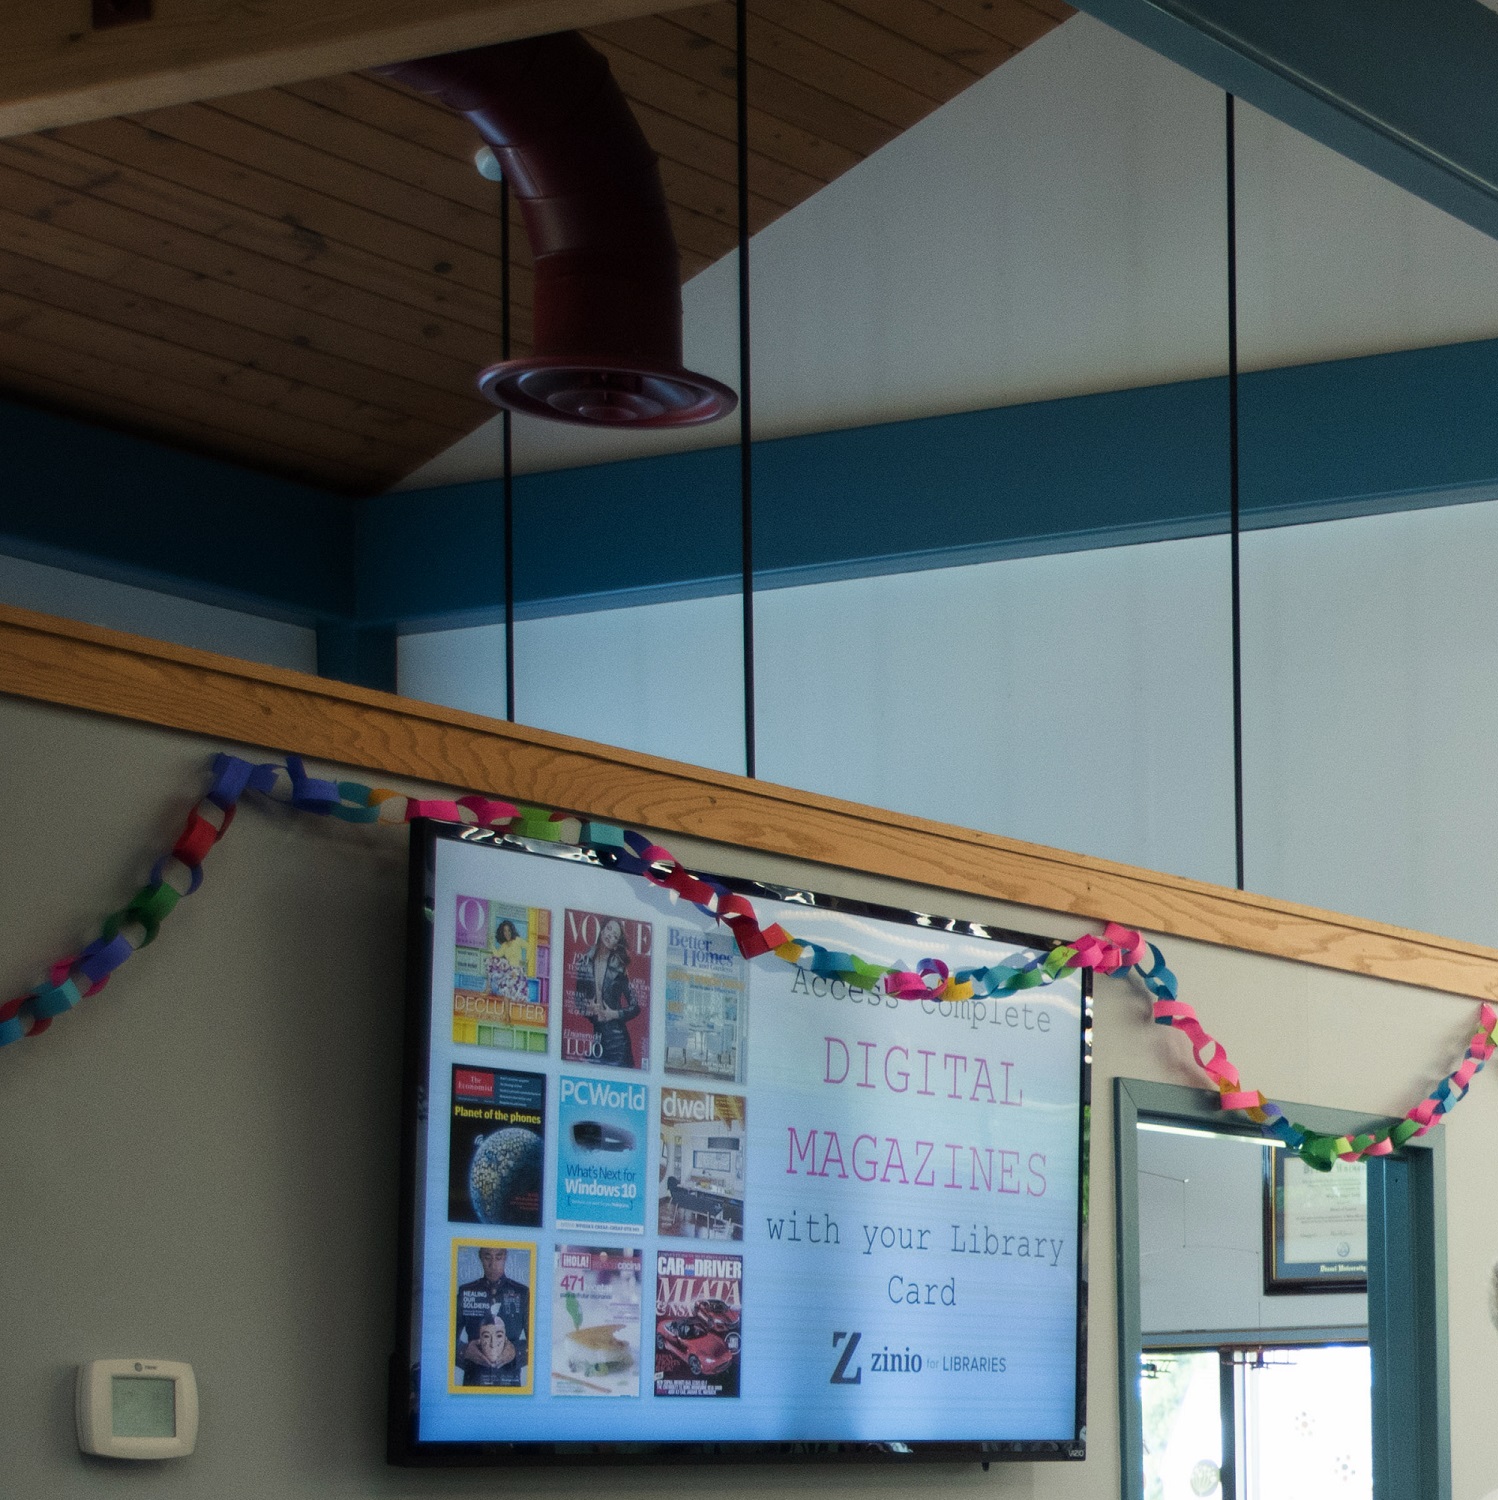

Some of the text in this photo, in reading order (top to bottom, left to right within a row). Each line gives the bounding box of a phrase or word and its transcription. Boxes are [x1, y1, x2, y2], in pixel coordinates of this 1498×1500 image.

[568, 911, 650, 956] VOE
[669, 928, 712, 951] Better
[682, 950, 733, 966] Homes
[567, 1039, 603, 1057] LUJO
[824, 1036, 1023, 1107] DIGITAL
[459, 1082, 493, 1092] Economist
[561, 1079, 645, 1111] PCWorld
[455, 1105, 541, 1124] Planet of the phones
[663, 1091, 714, 1120] dwell
[566, 1164, 636, 1180] What's Next for
[786, 1127, 1047, 1197] MAGAZINES
[565, 1178, 636, 1198] Windows 10
[766, 1210, 1064, 1267] with your Library
[658, 1257, 684, 1276] CAR
[695, 1260, 742, 1279] DRIVER
[560, 1275, 585, 1290] 471
[657, 1278, 741, 1308] MIATA
[888, 1275, 957, 1306] Card
[870, 1346, 923, 1373] zinio
[926, 1358, 940, 1370] for
[942, 1356, 1006, 1373] LIBRARIES
[1067, 1449, 1084, 1457] VIZIO
